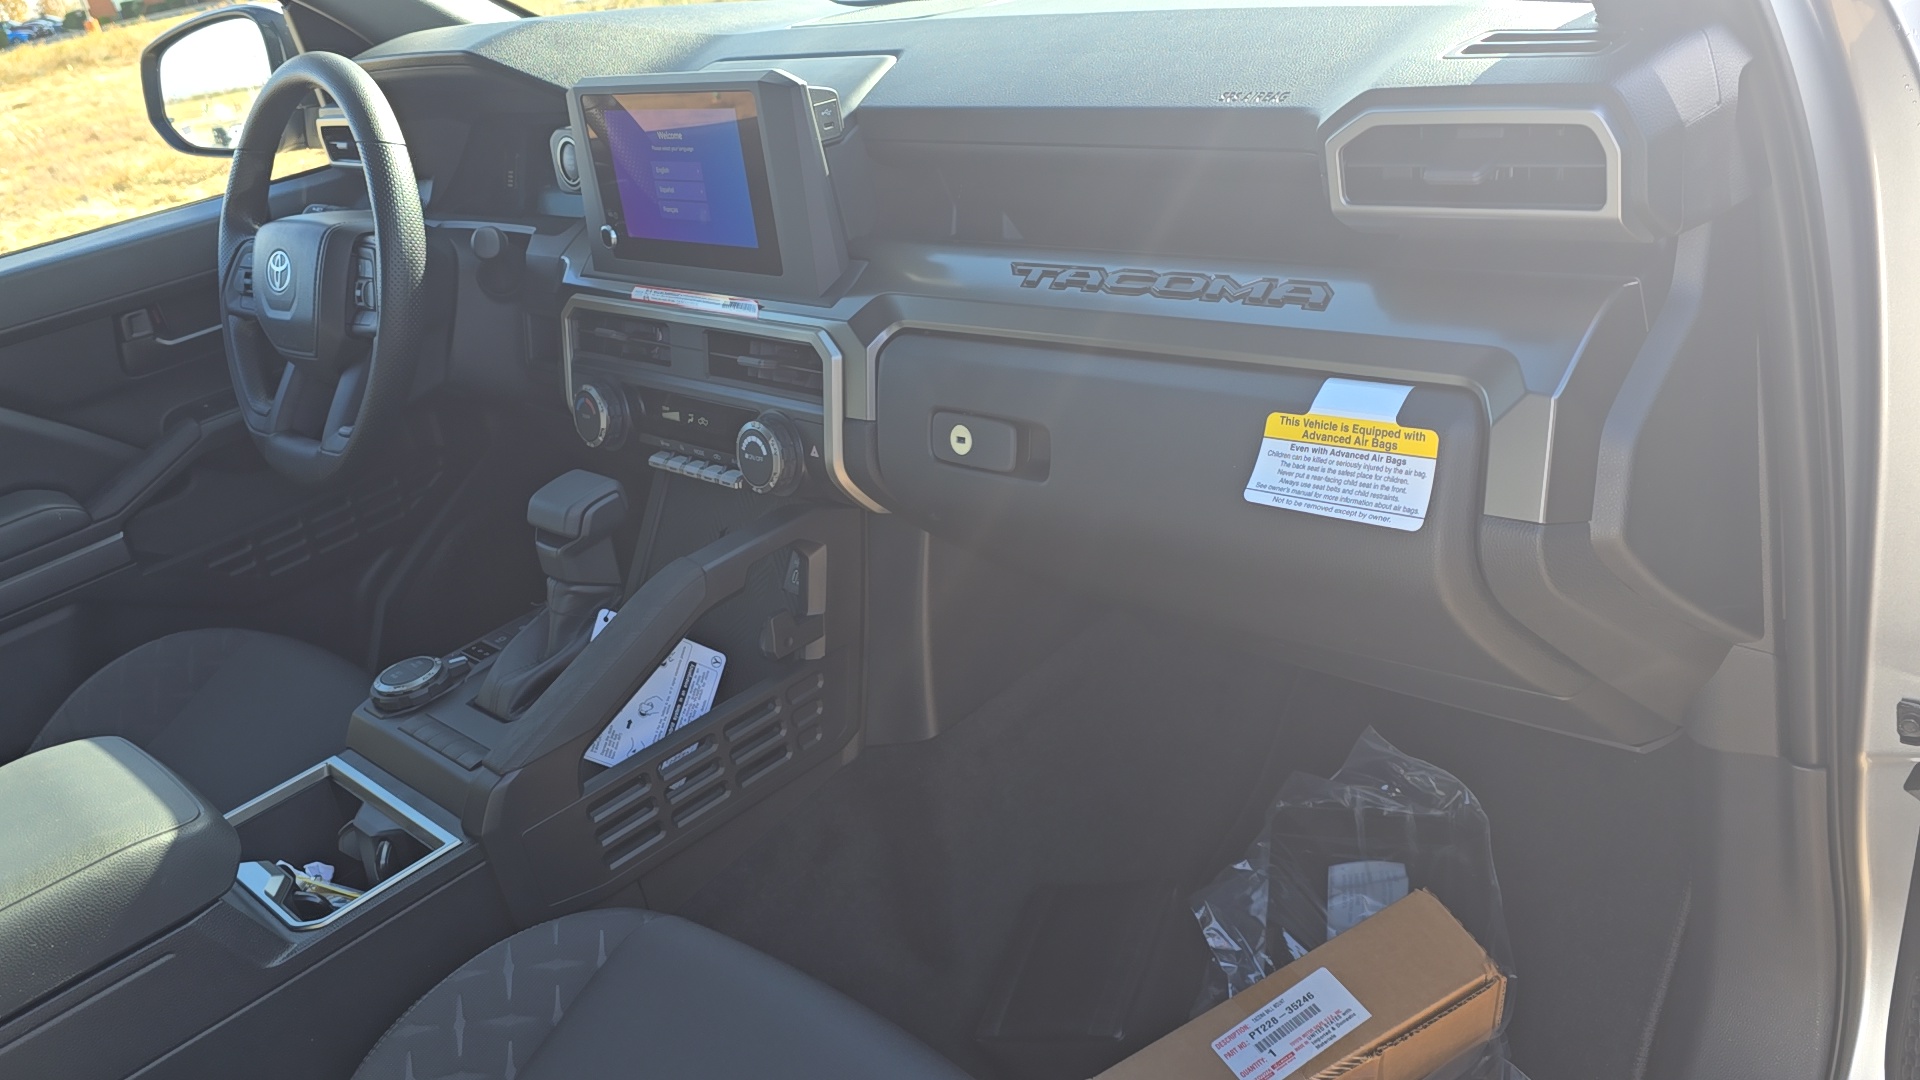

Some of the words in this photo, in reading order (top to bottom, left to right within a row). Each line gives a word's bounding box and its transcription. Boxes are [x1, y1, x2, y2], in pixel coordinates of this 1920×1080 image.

[656, 131, 683, 140] Welcome
[1011, 262, 1335, 311] TACOMA
[1280, 416, 1300, 426] This
[1303, 418, 1338, 431] Vehicle
[1340, 422, 1349, 433] is
[1352, 424, 1401, 439] Equipped
[1404, 431, 1426, 442] with
[1302, 430, 1351, 444] Advanced
[1354, 435, 1369, 447] Air
[1372, 438, 1398, 451] Bags
[1267, 449, 1290, 458] Children
[1312, 456, 1327, 464] killed
[1335, 459, 1361, 470] seriously
[1362, 463, 1383, 473] injured
[1384, 466, 1392, 474] by
[1413, 470, 1427, 479] bag.
[1290, 443, 1308, 452] Even
[1311, 446, 1327, 454] with
[1329, 448, 1369, 460] Advanced
[1371, 454, 1383, 462] Air
[1385, 455, 1406, 466] Bags
[1291, 461, 1305, 469] back
[1326, 466, 1336, 474] the
[1337, 468, 1355, 477] safest
[1356, 470, 1373, 480] place
[1383, 474, 1409, 484] children.
[1310, 474, 1341, 485] rear-facing
[1343, 478, 1358, 486] child
[1391, 485, 1407, 494] front.
[1255, 481, 1267, 489] See
[1267, 484, 1290, 493] owner's
[1290, 487, 1313, 497] manual
[1322, 493, 1338, 501] more
[1339, 495, 1373, 507] information
[1374, 501, 1392, 509] about
[1402, 505, 1419, 515] bags.
[1278, 477, 1299, 486] Always
[1354, 489, 1369, 497] child
[1369, 492, 1399, 502] restraints.
[1272, 495, 1284, 503] Not
[1303, 502, 1333, 512] removed
[1333, 507, 1357, 517] except
[1358, 511, 1367, 519] by
[1368, 514, 1391, 522] owner.
[1214, 1022, 1251, 1050] DESCRIPTION:
[1310, 1029, 1331, 1045] Imported
[1335, 1011, 1356, 1027] Domestic
[1223, 1046, 1238, 1060] PART
[1266, 1047, 1276, 1059] 1
[1314, 1033, 1336, 1050] Materials
